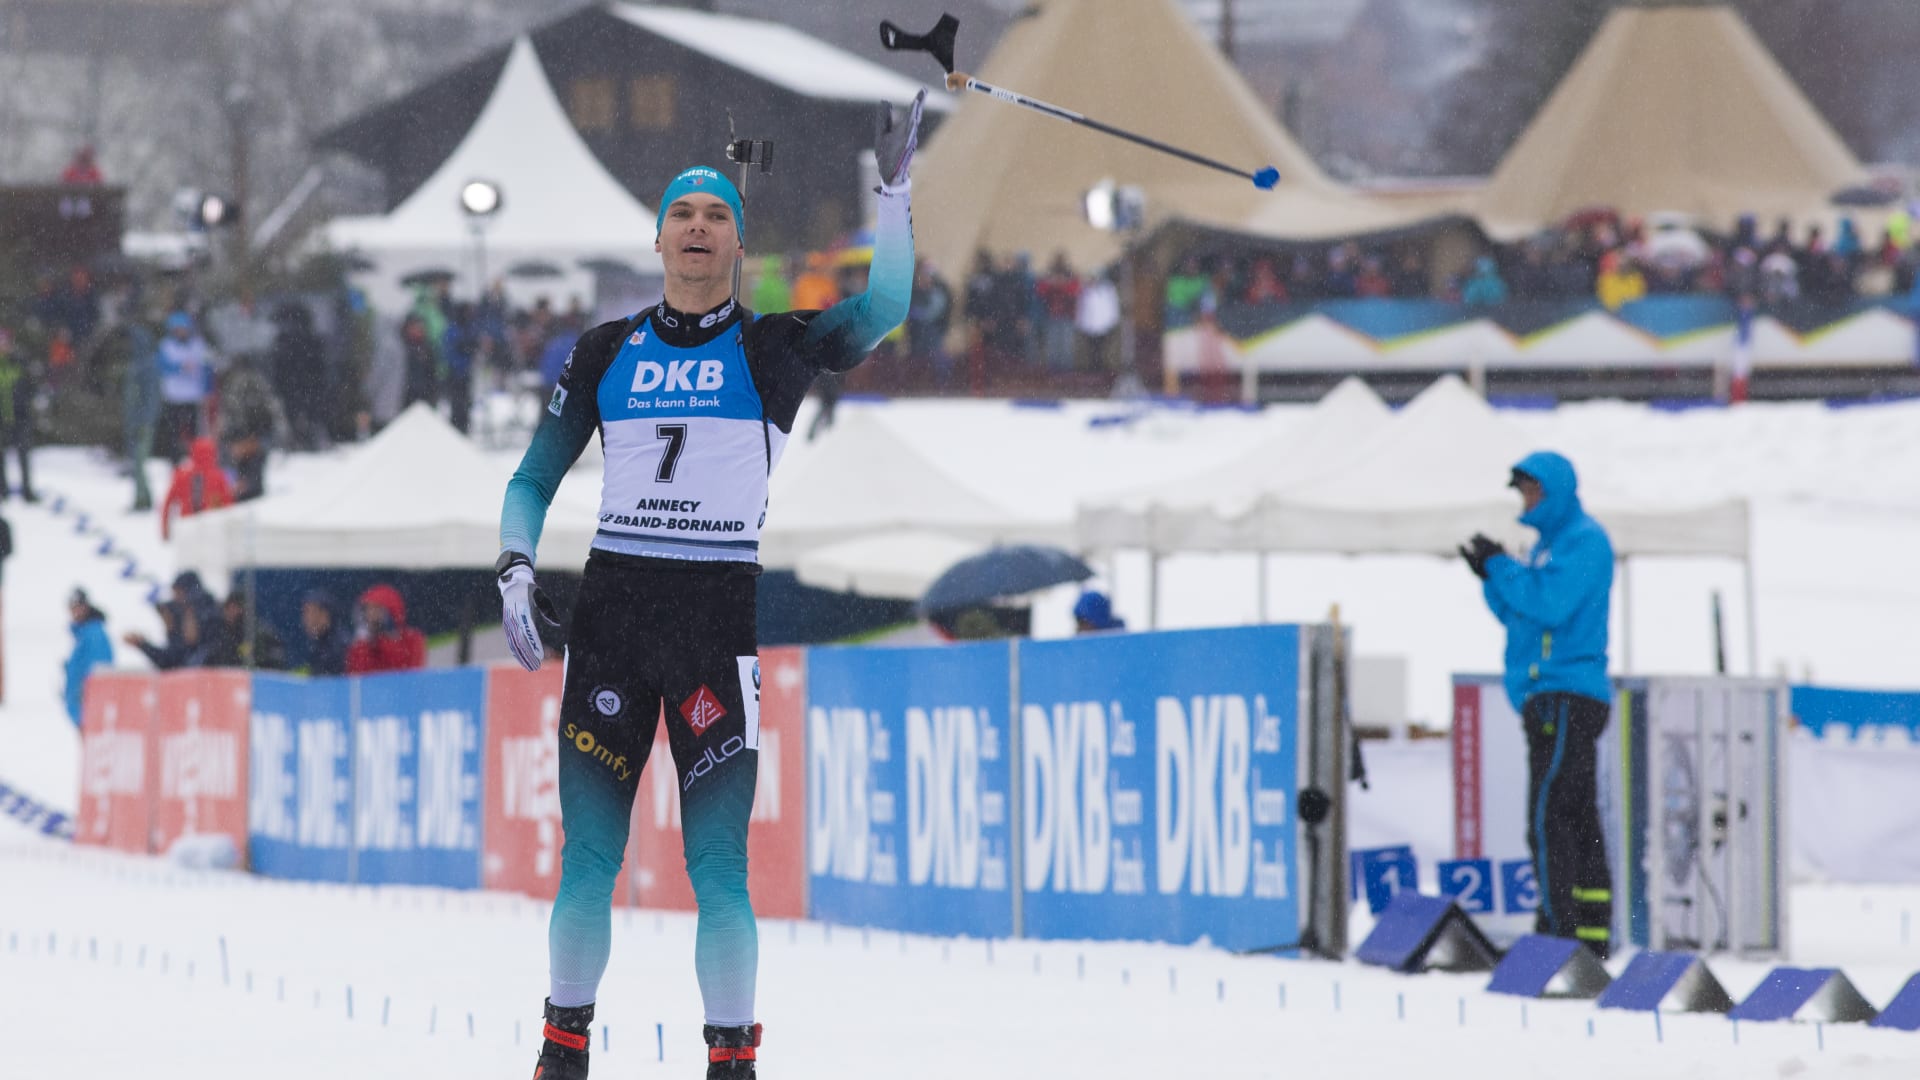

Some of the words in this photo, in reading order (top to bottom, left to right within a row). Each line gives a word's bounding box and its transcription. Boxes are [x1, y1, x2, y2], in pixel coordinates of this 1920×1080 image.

[630, 360, 724, 393] DKB
[627, 397, 651, 408] Das
[655, 397, 685, 408] kann
[689, 395, 720, 408] Bank
[655, 423, 688, 483] 7
[613, 515, 745, 533] GRAND-BORNAND
[636, 498, 702, 513] ANNECY
[564, 722, 632, 781] somfy
[1022, 702, 1111, 893] DKB
[1156, 694, 1250, 897] DKB
[1380, 865, 1400, 897] 1
[1451, 864, 1485, 909] 2
[1515, 864, 1542, 909] 3
